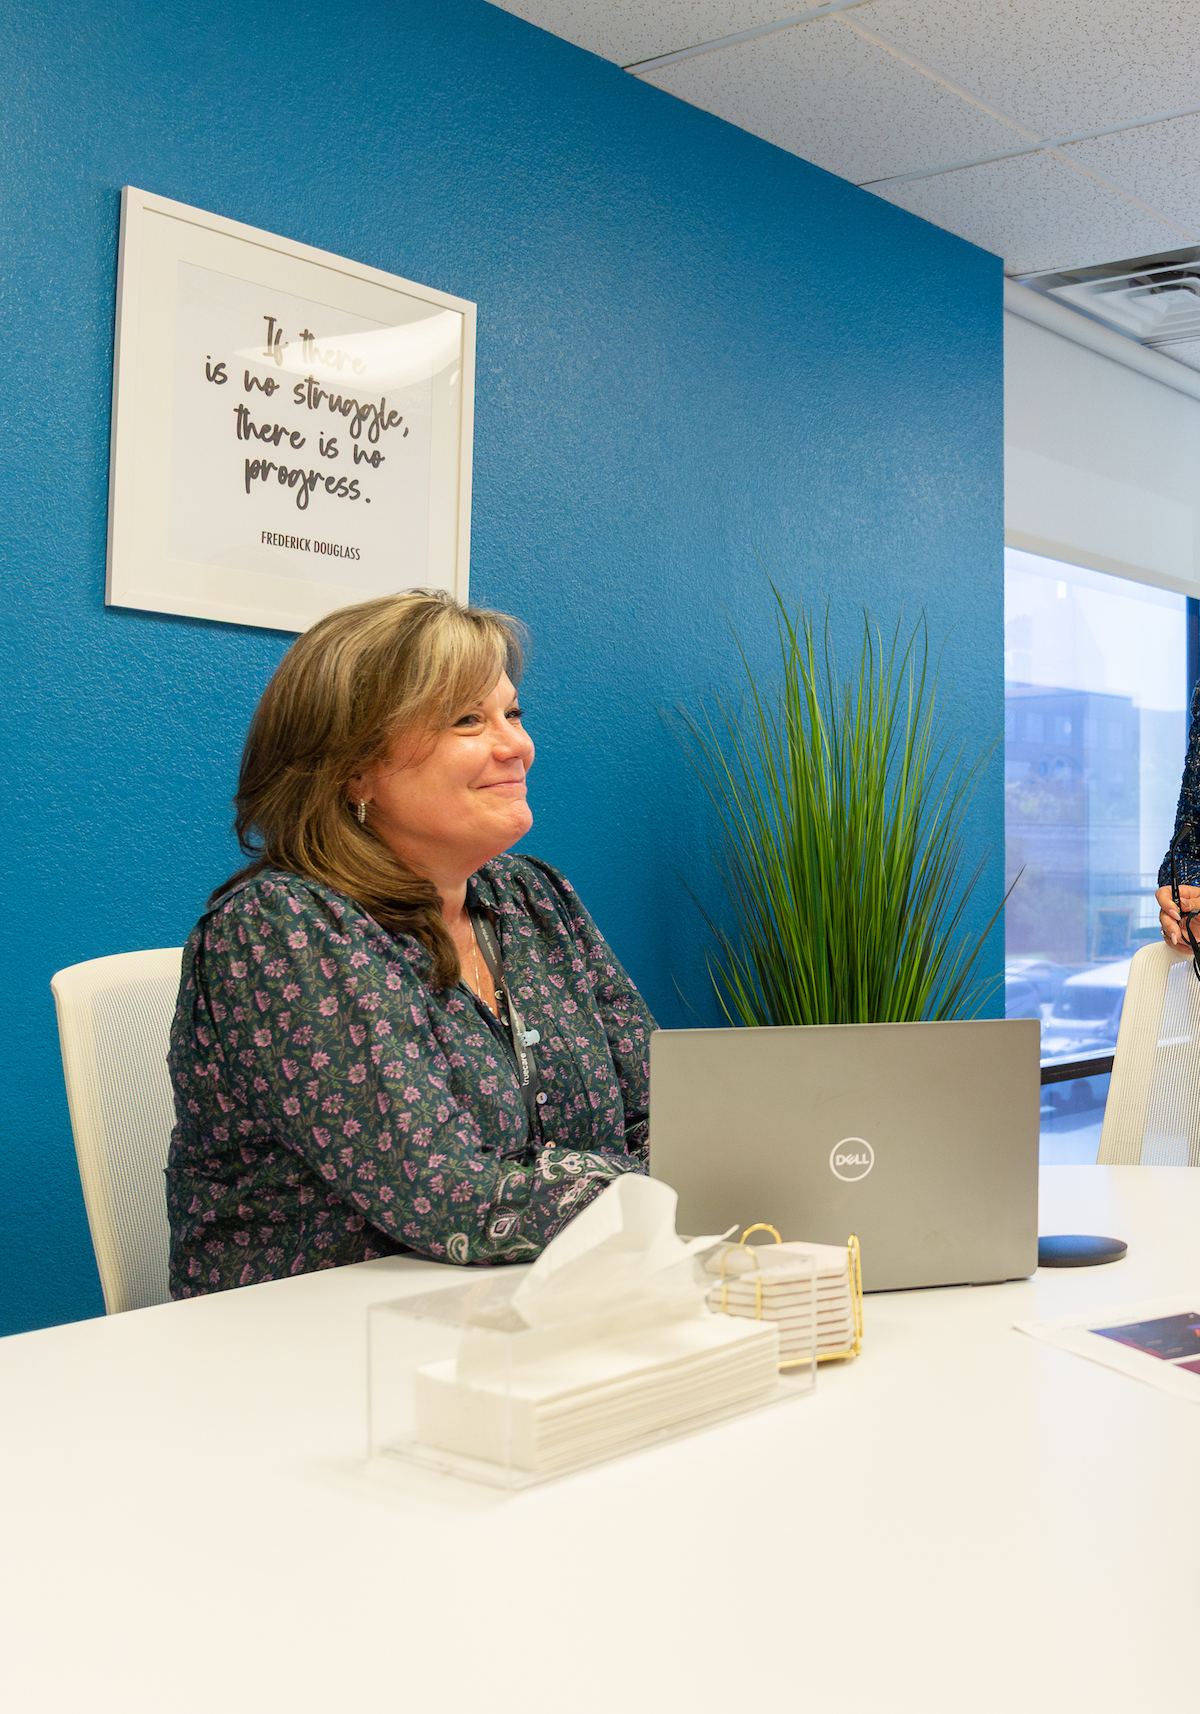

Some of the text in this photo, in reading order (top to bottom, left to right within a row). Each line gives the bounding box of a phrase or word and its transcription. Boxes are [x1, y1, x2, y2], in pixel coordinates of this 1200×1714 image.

[262, 315, 368, 377] If there
[205, 355, 410, 443] is no struggle,
[234, 404, 387, 470] there is no
[245, 456, 372, 511] progress.
[261, 530, 361, 561] FREDERICK DOUGLASS
[520, 1052, 530, 1087] truecare
[835, 1153, 869, 1166] DELL
